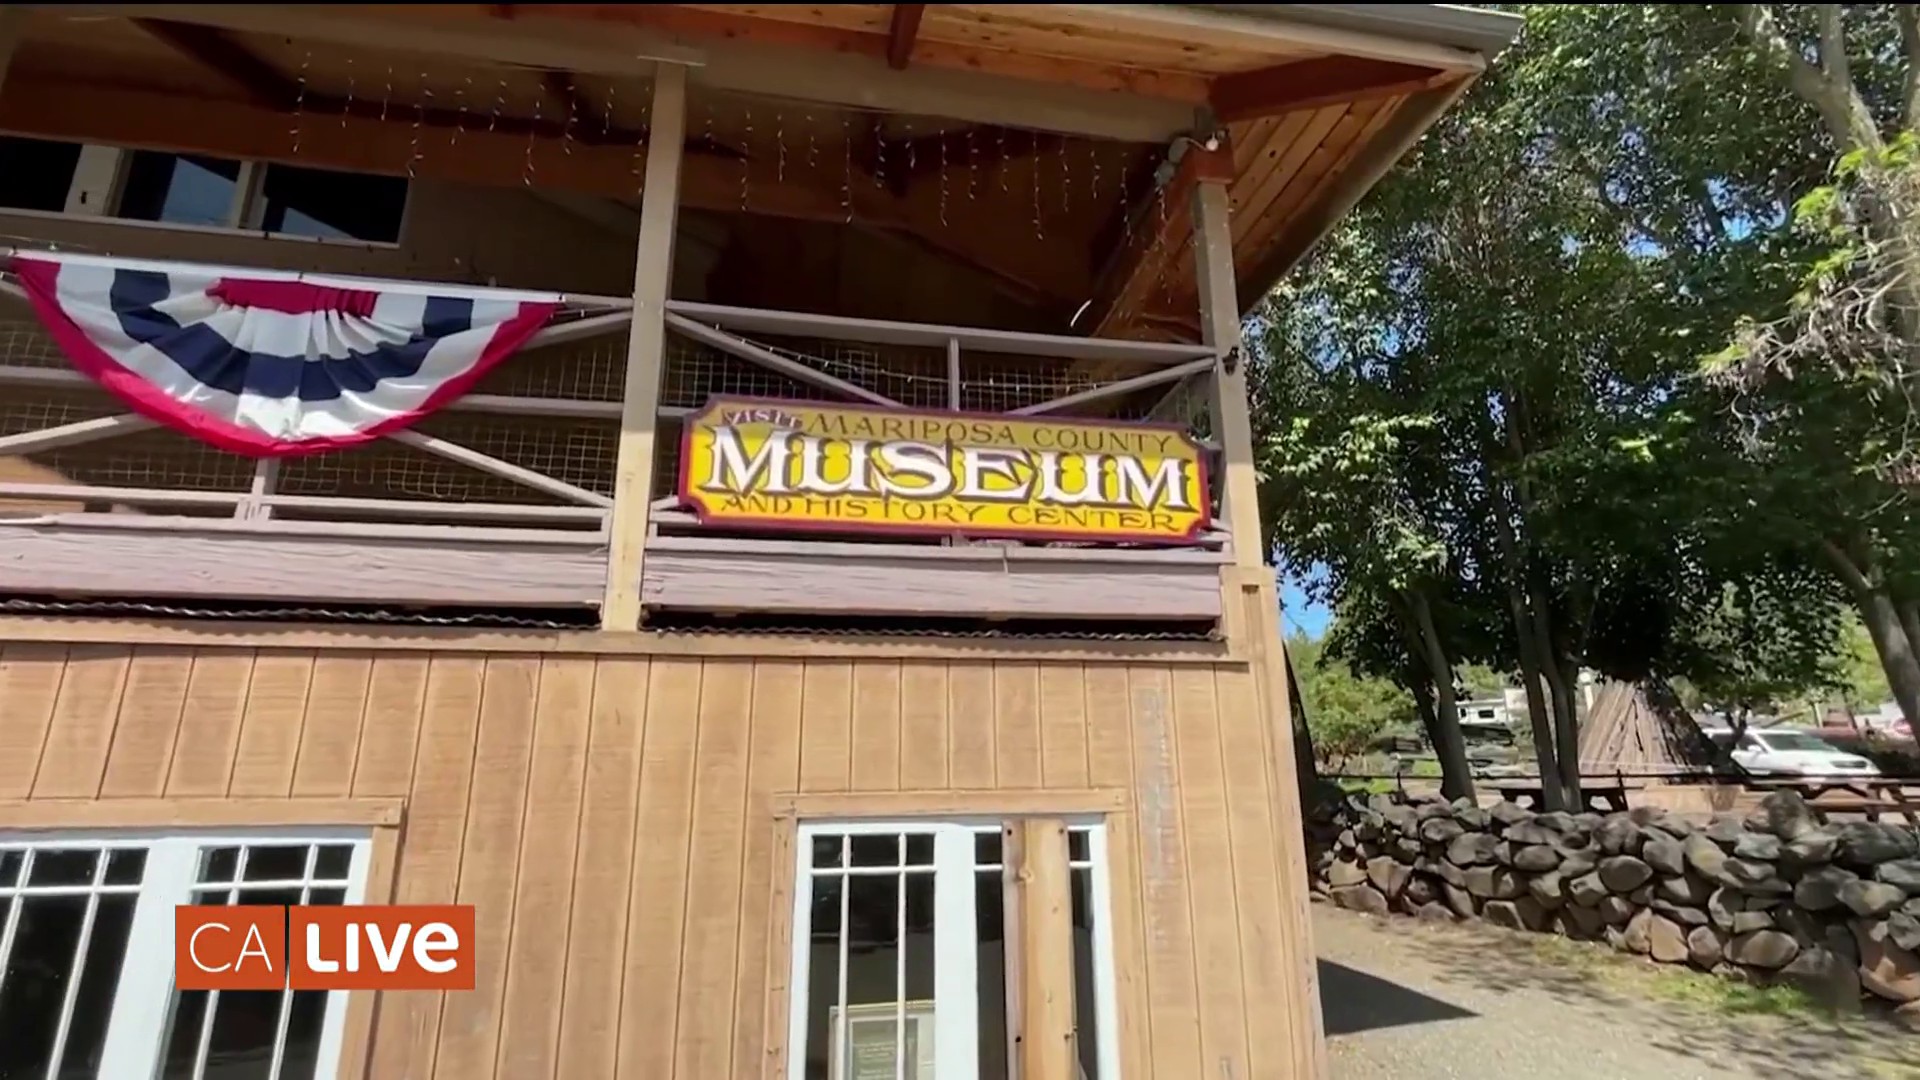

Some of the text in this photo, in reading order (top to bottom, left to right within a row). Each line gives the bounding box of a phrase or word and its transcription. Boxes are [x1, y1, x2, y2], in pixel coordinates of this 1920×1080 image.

[722, 409, 802, 429] VISIT
[807, 412, 1173, 453] MARIPOSA COUNTY
[701, 424, 1197, 511] MUSEUM
[721, 494, 1181, 532] AND HISTORY CENTER
